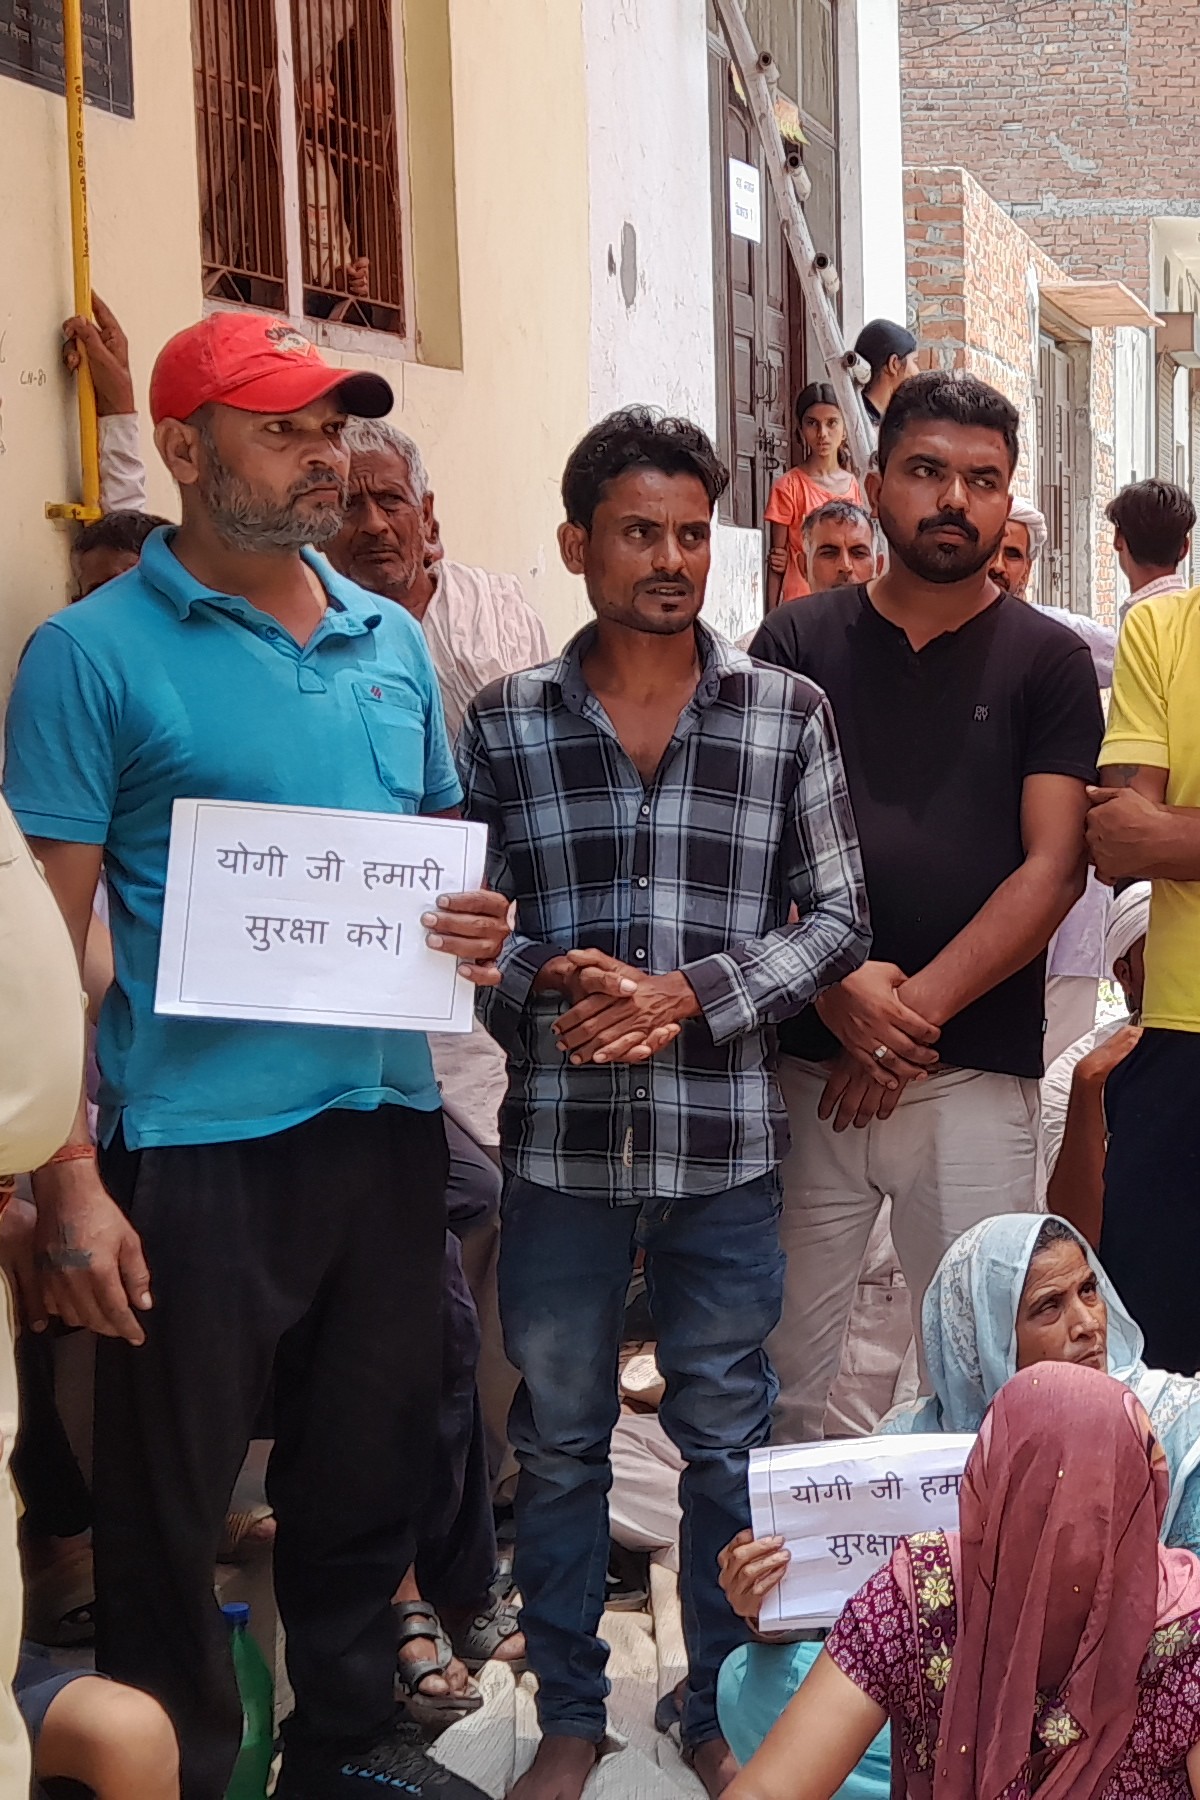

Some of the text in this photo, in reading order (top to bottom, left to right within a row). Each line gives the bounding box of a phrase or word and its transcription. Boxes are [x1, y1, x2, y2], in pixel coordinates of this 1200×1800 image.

[216, 842, 444, 891] योगी जी हमारी
[245, 914, 329, 951] सुरक्षा
[790, 1471, 964, 1504] योगी जी हम
[826, 1533, 898, 1565] सुरक्षा
